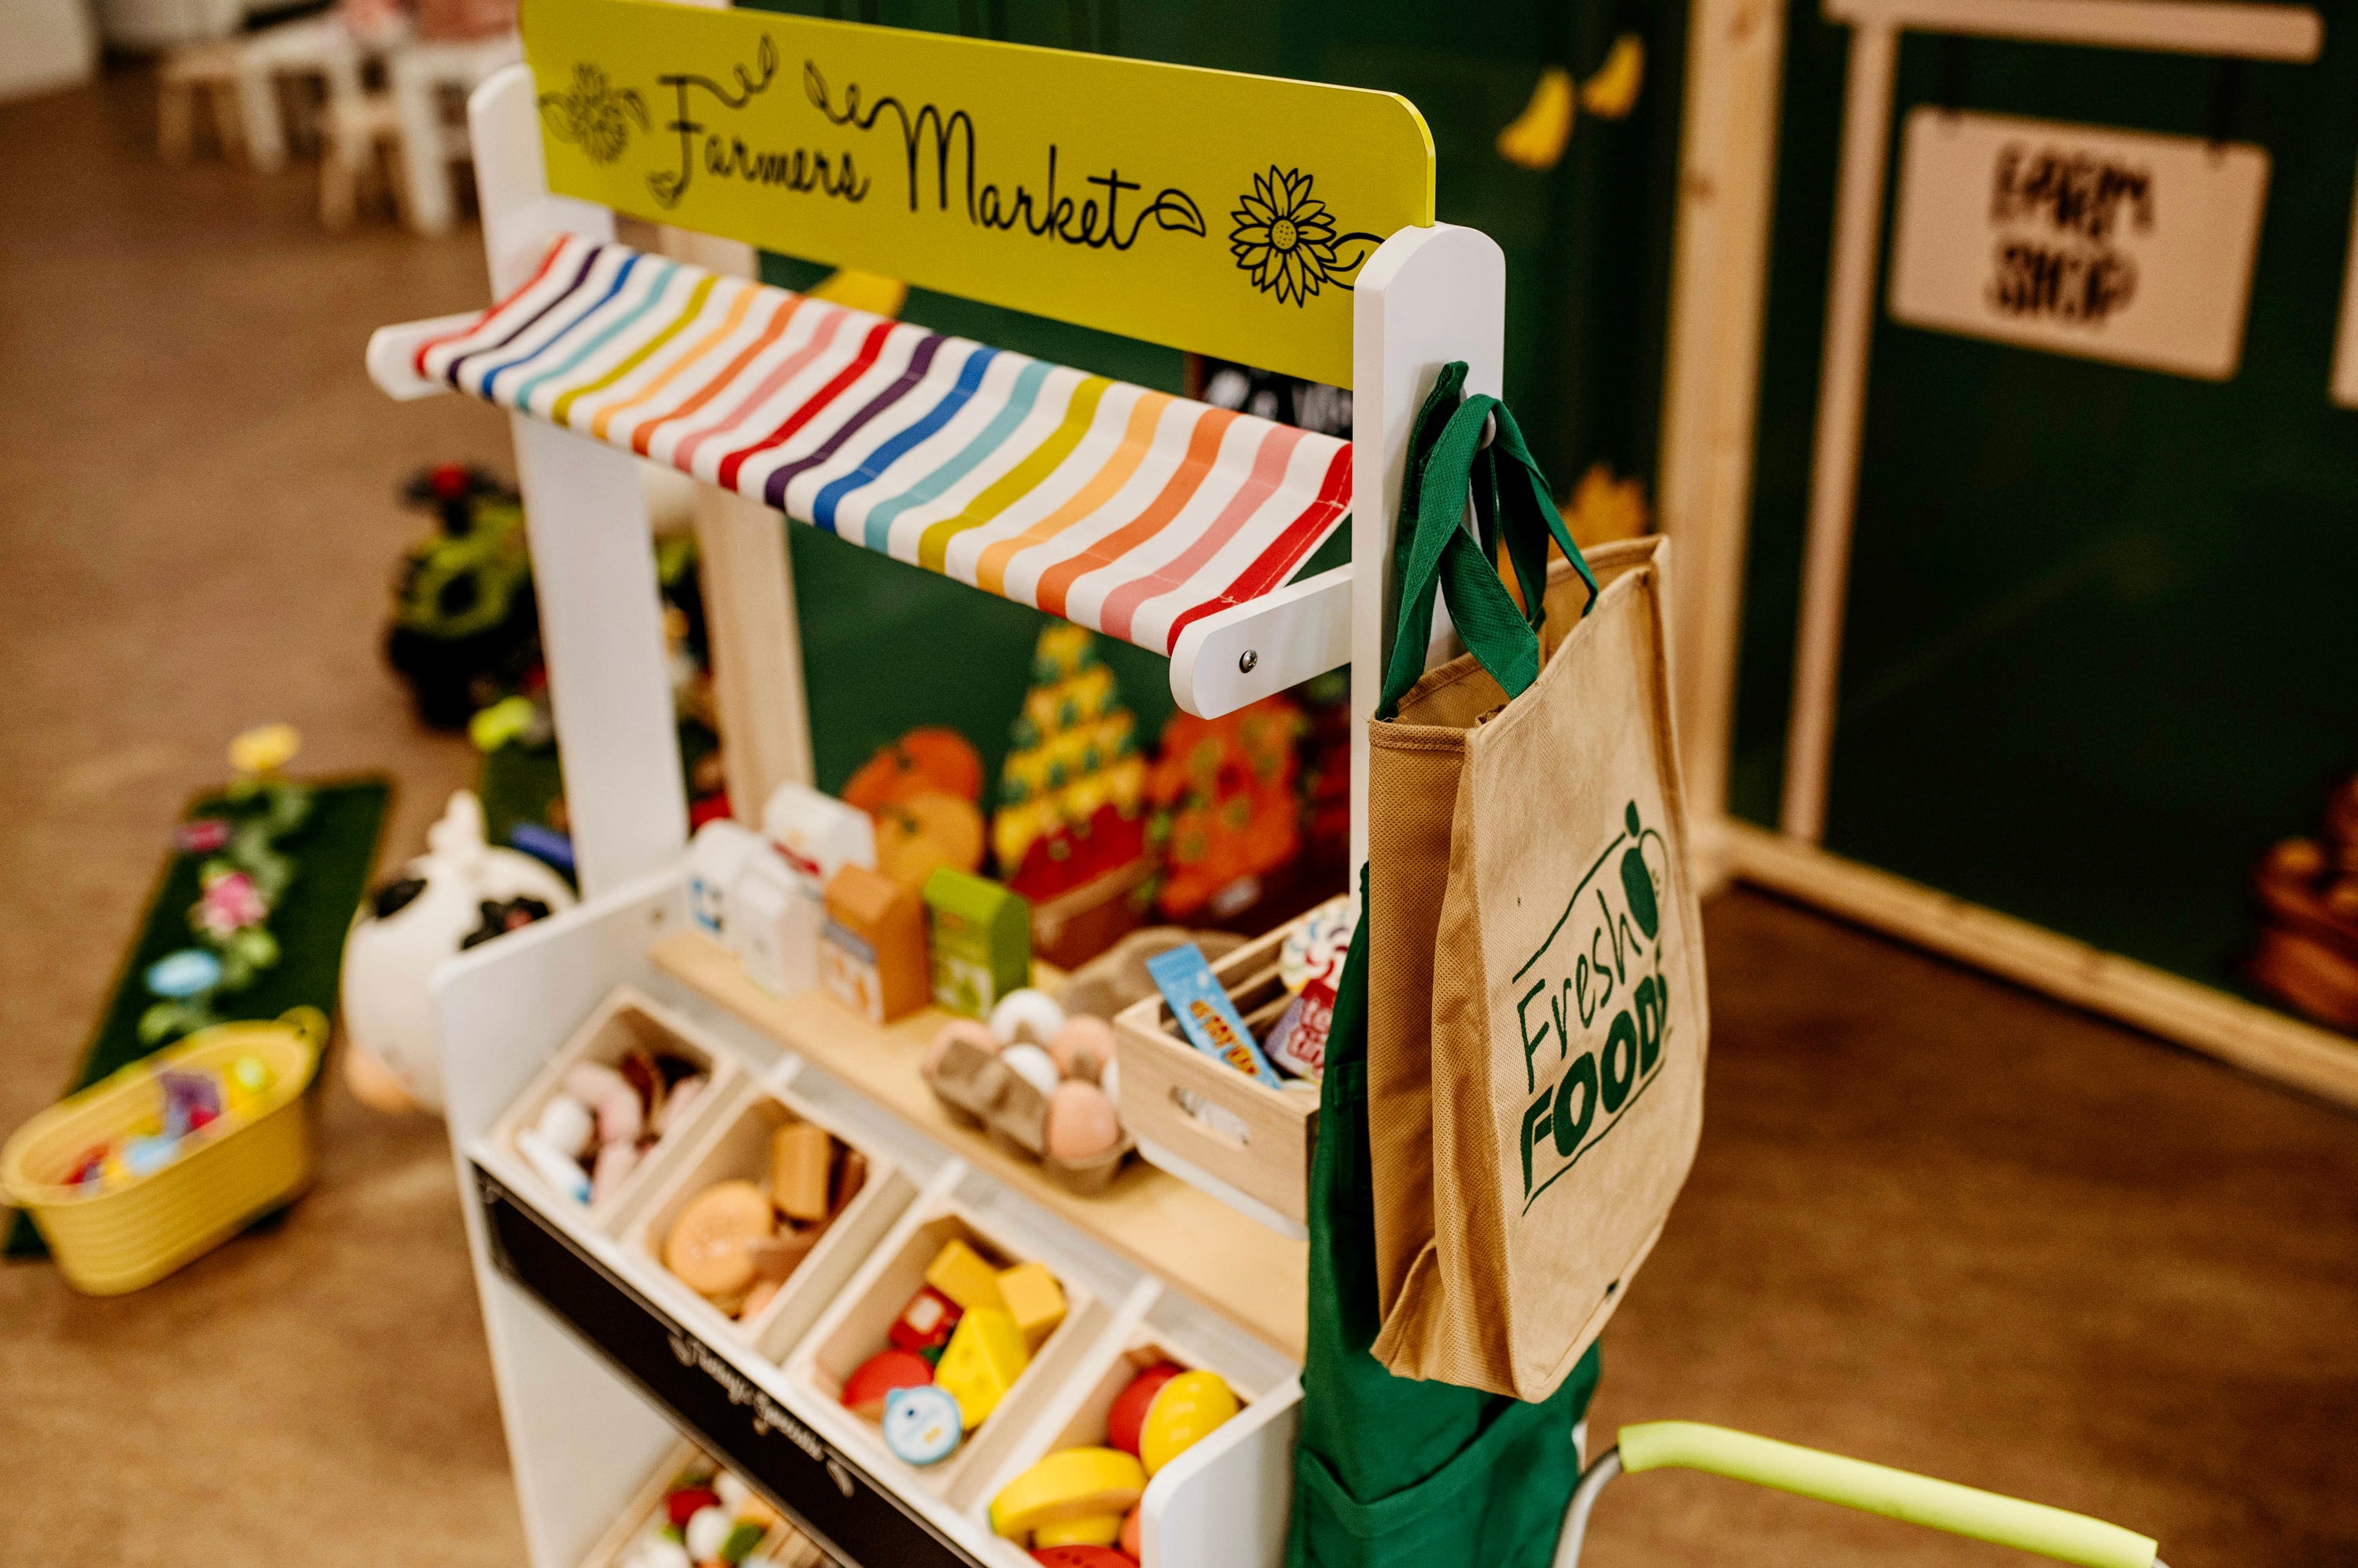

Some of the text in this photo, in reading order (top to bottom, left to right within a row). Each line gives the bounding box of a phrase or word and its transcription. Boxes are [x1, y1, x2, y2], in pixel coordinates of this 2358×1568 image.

[649, 66, 1149, 252] Farmers Market
[1517, 889, 1643, 1095] Fresh
